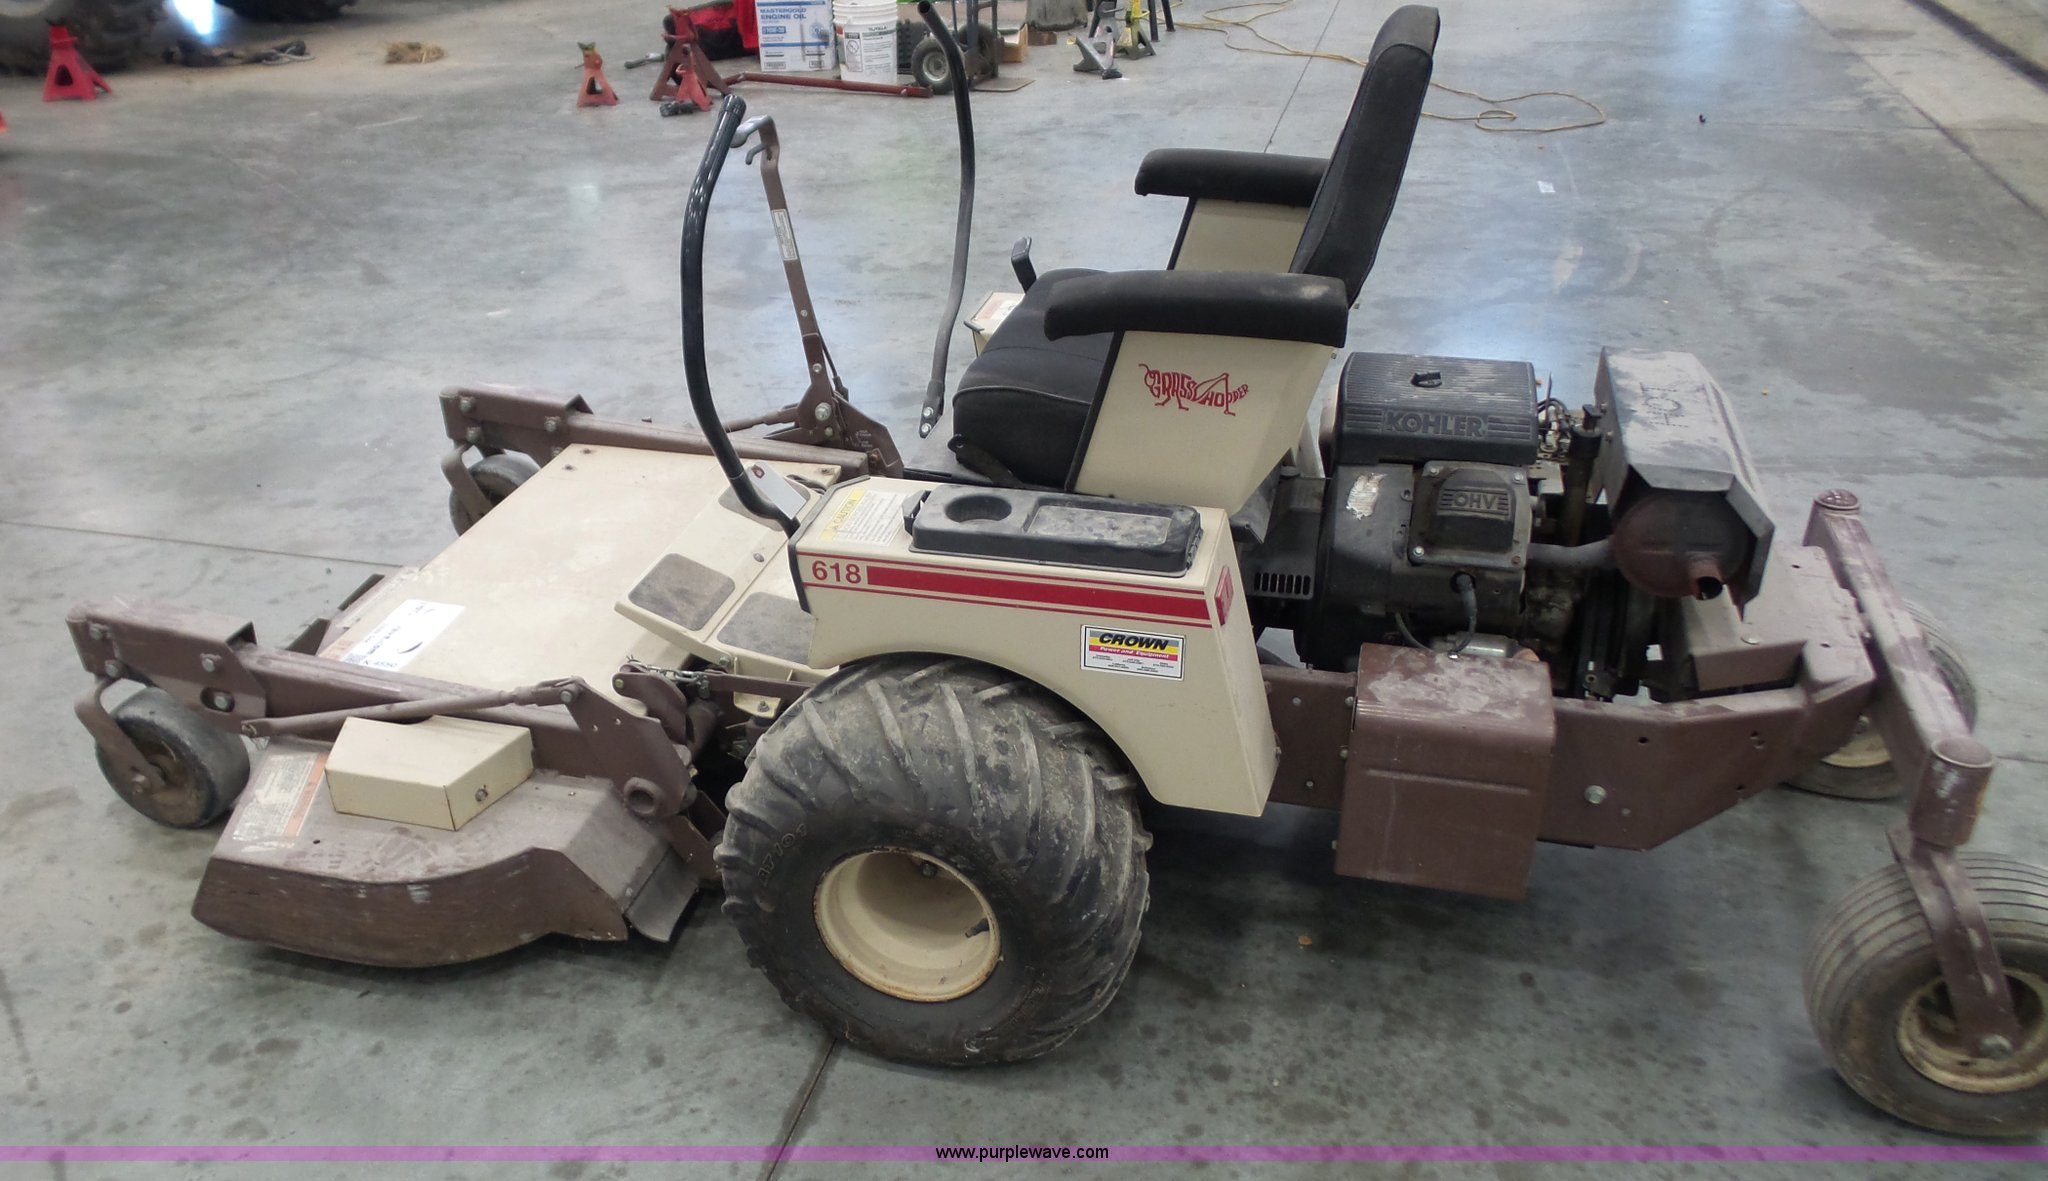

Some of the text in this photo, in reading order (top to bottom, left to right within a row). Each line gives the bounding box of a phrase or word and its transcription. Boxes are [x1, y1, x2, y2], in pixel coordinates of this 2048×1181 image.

[1384, 410, 1482, 438] KOHLER
[1454, 493, 1494, 509] OHV
[811, 560, 862, 584] 618
[1099, 633, 1169, 650] CROWN
[1136, 650, 1169, 659] Equipment
